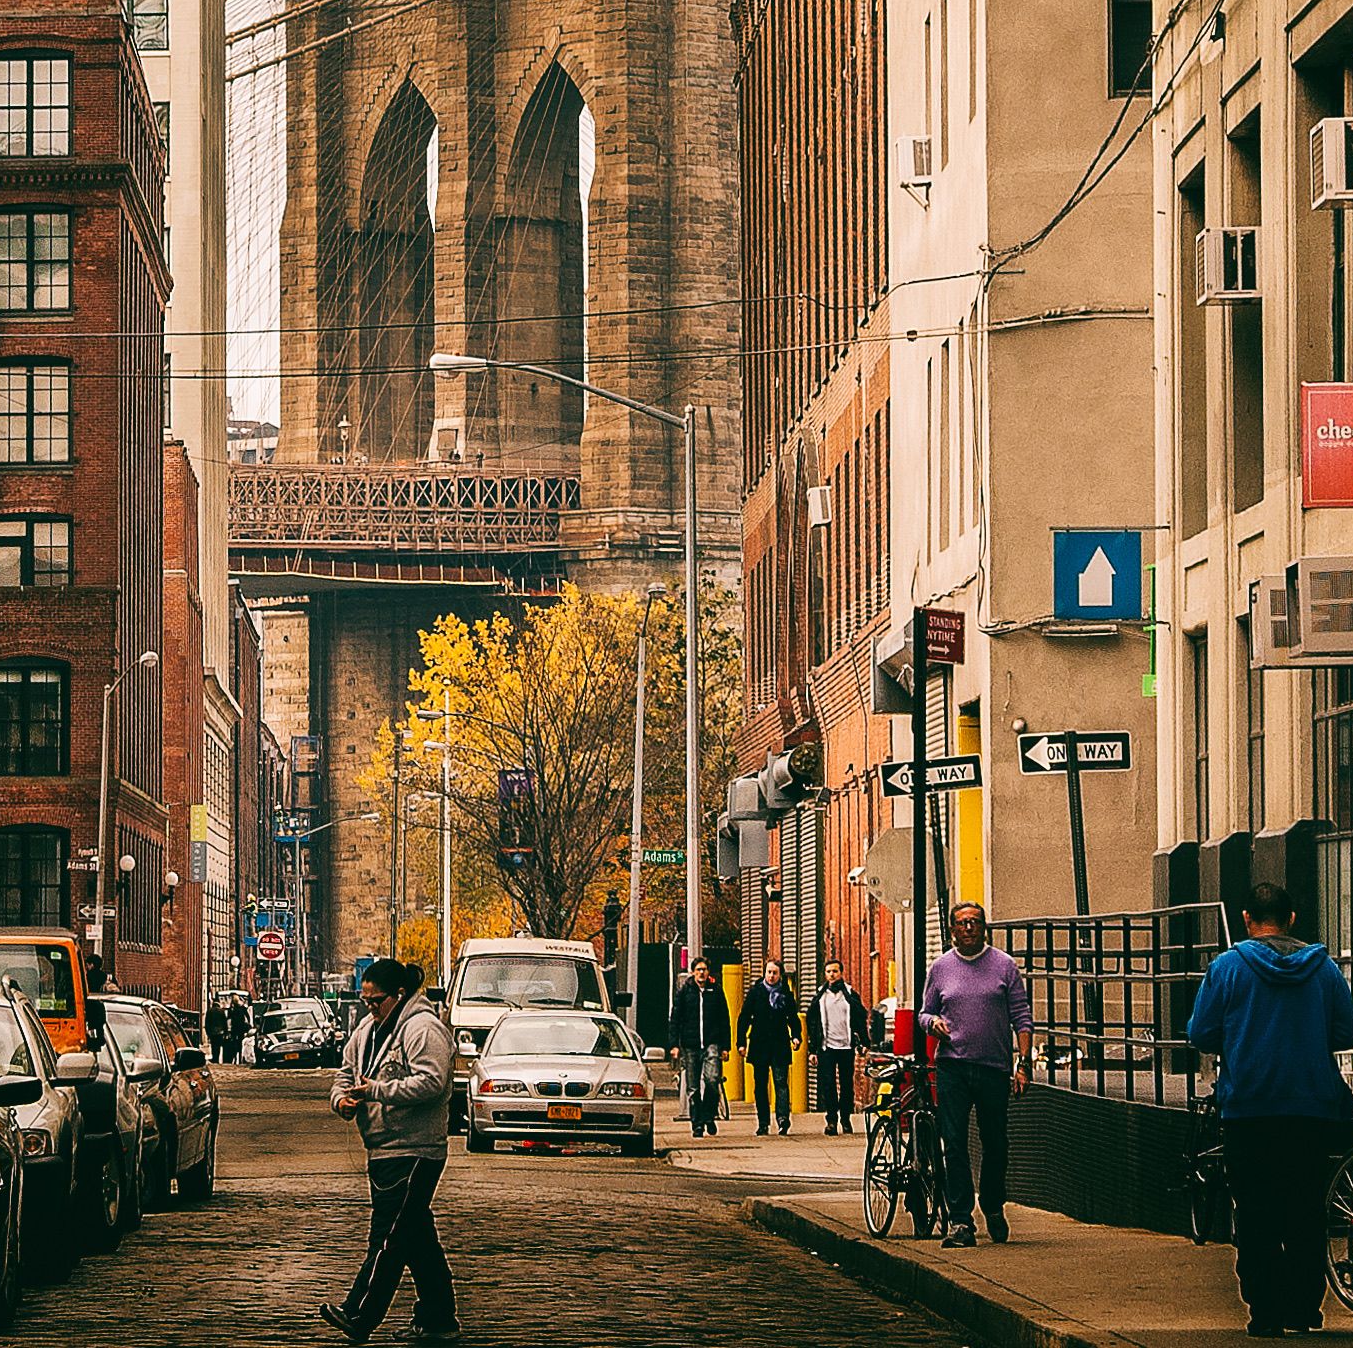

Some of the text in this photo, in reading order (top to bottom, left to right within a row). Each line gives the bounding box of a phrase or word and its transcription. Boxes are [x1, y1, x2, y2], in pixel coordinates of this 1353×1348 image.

[928, 615, 962, 631] STANDING
[926, 629, 956, 643] NYTIME
[1047, 744, 1118, 761] ON WAY
[936, 766, 968, 782] WAY
[643, 851, 676, 862] Adams
